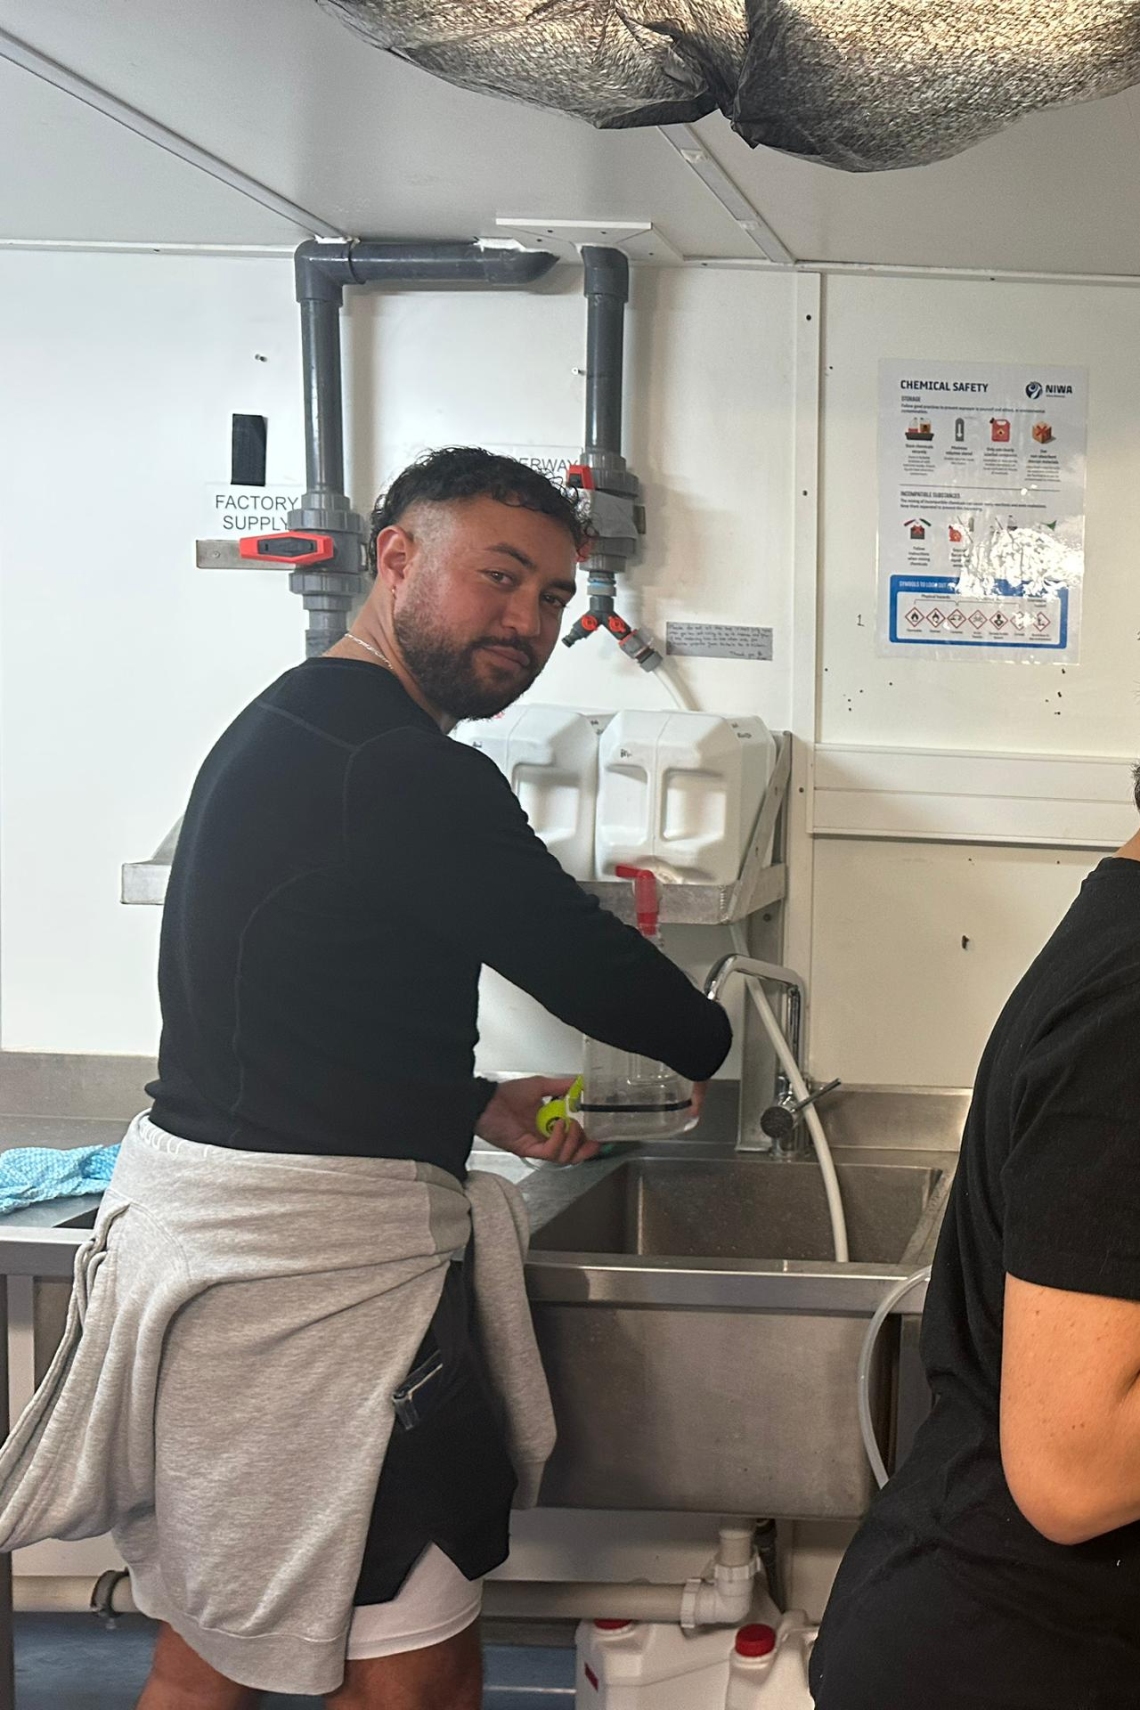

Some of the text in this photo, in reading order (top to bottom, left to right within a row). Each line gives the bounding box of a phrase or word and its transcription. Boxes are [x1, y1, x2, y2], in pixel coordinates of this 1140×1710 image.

[901, 380, 989, 393] CHEMICAL SAFETY
[1045, 384, 1073, 395] NIWA
[215, 495, 299, 511] FACTORY
[223, 515, 288, 531] SUPPLY
